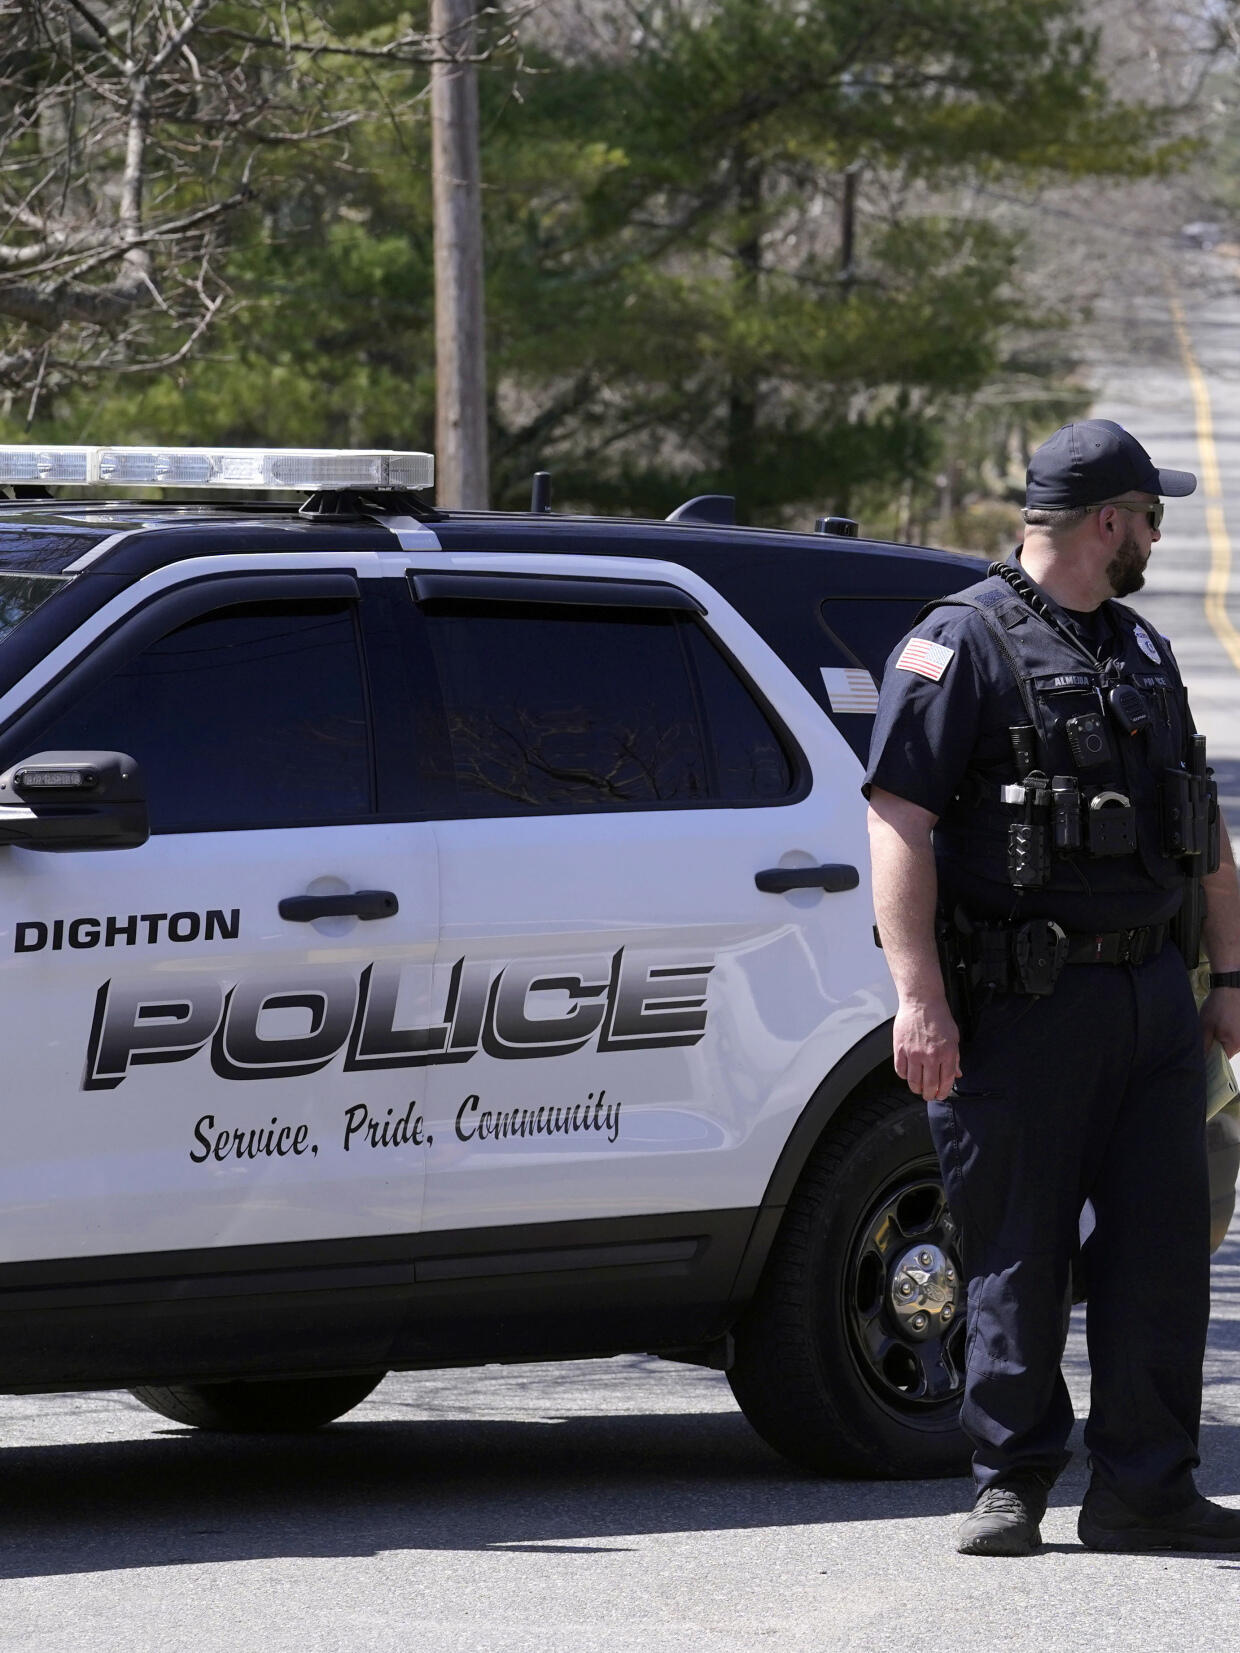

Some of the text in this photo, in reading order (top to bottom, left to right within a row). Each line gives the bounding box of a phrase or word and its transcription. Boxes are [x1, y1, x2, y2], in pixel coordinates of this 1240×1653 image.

[1054, 675, 1089, 686] ALMEIDA
[14, 908, 241, 953] DIGHTON
[80, 945, 716, 1091] POLICE
[189, 1089, 622, 1164] Service, Pride, Community
